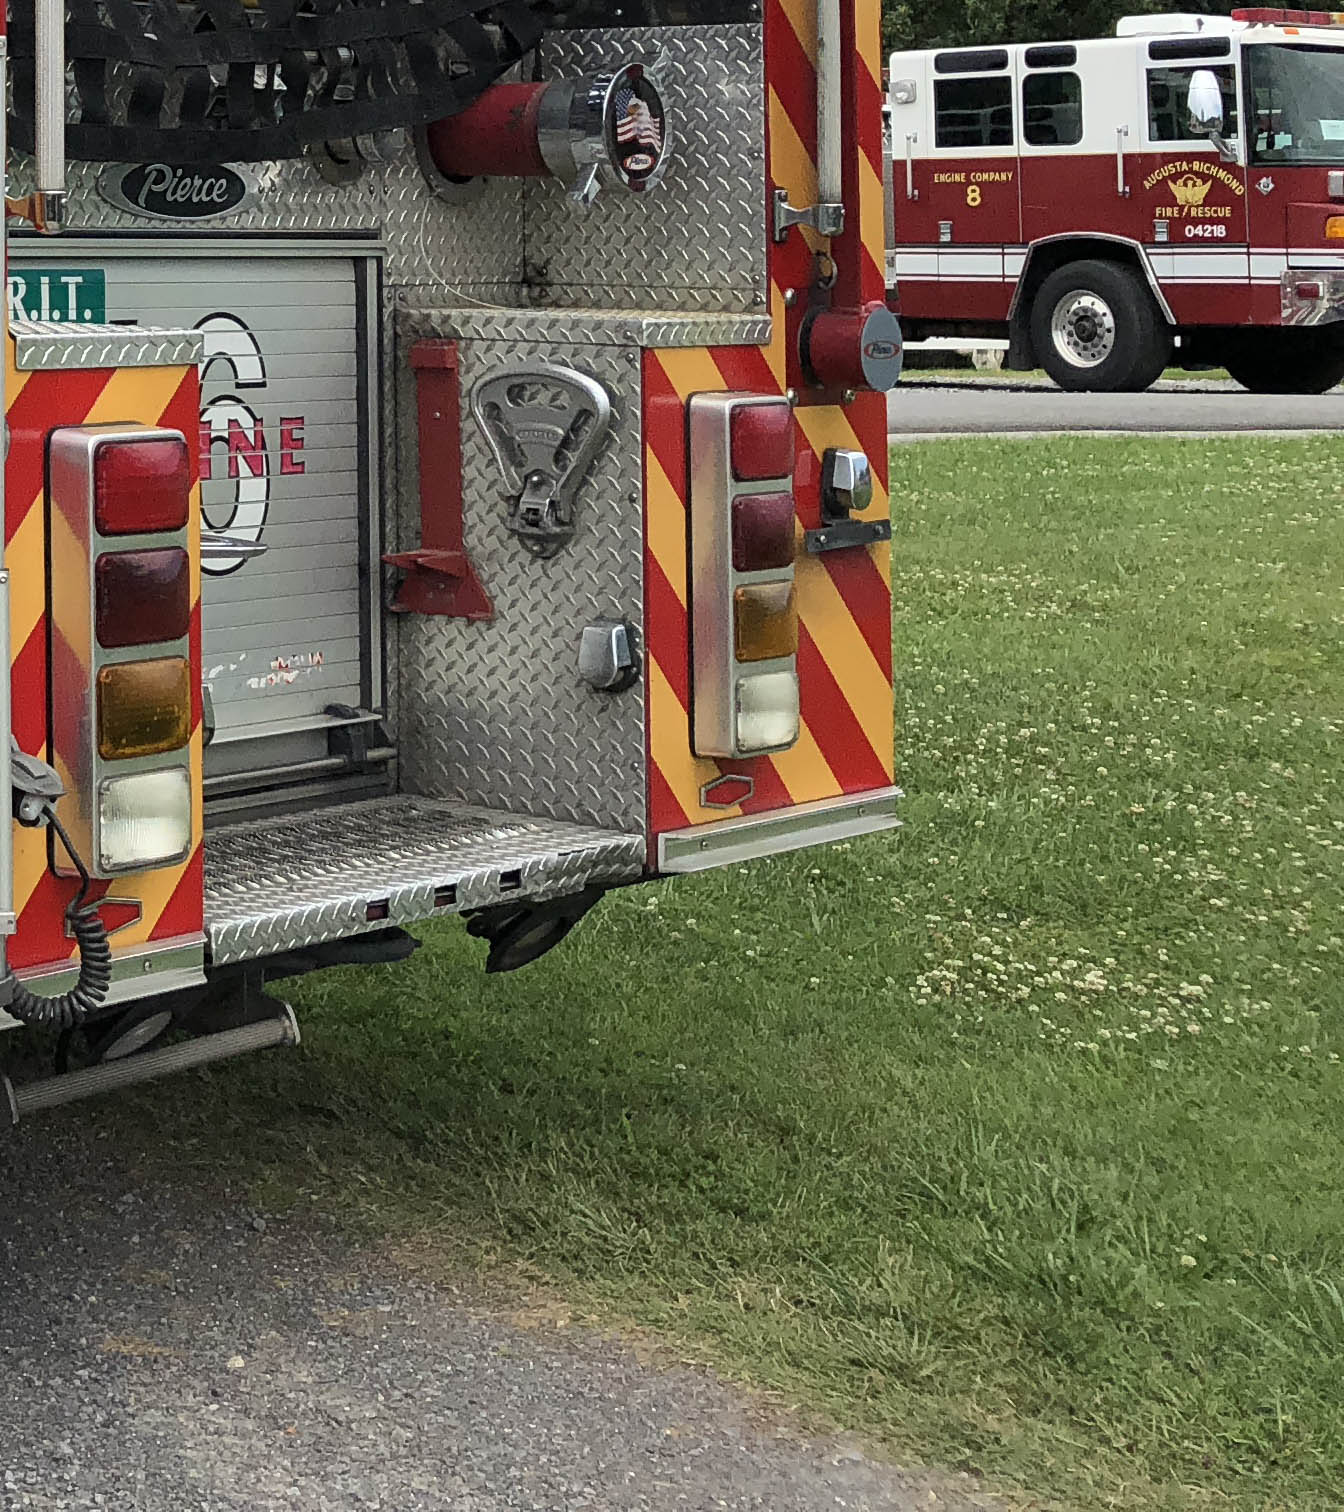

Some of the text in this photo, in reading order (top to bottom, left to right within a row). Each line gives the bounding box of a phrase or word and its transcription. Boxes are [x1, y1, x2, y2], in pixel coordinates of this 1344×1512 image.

[137, 163, 229, 208] Pierce
[934, 171, 1013, 183] ENGINE COMPANY
[1143, 160, 1246, 196] AUGUSTA-RICHMOND
[966, 184, 982, 207] 8
[1184, 224, 1227, 238] 04218
[190, 311, 270, 576] 6
